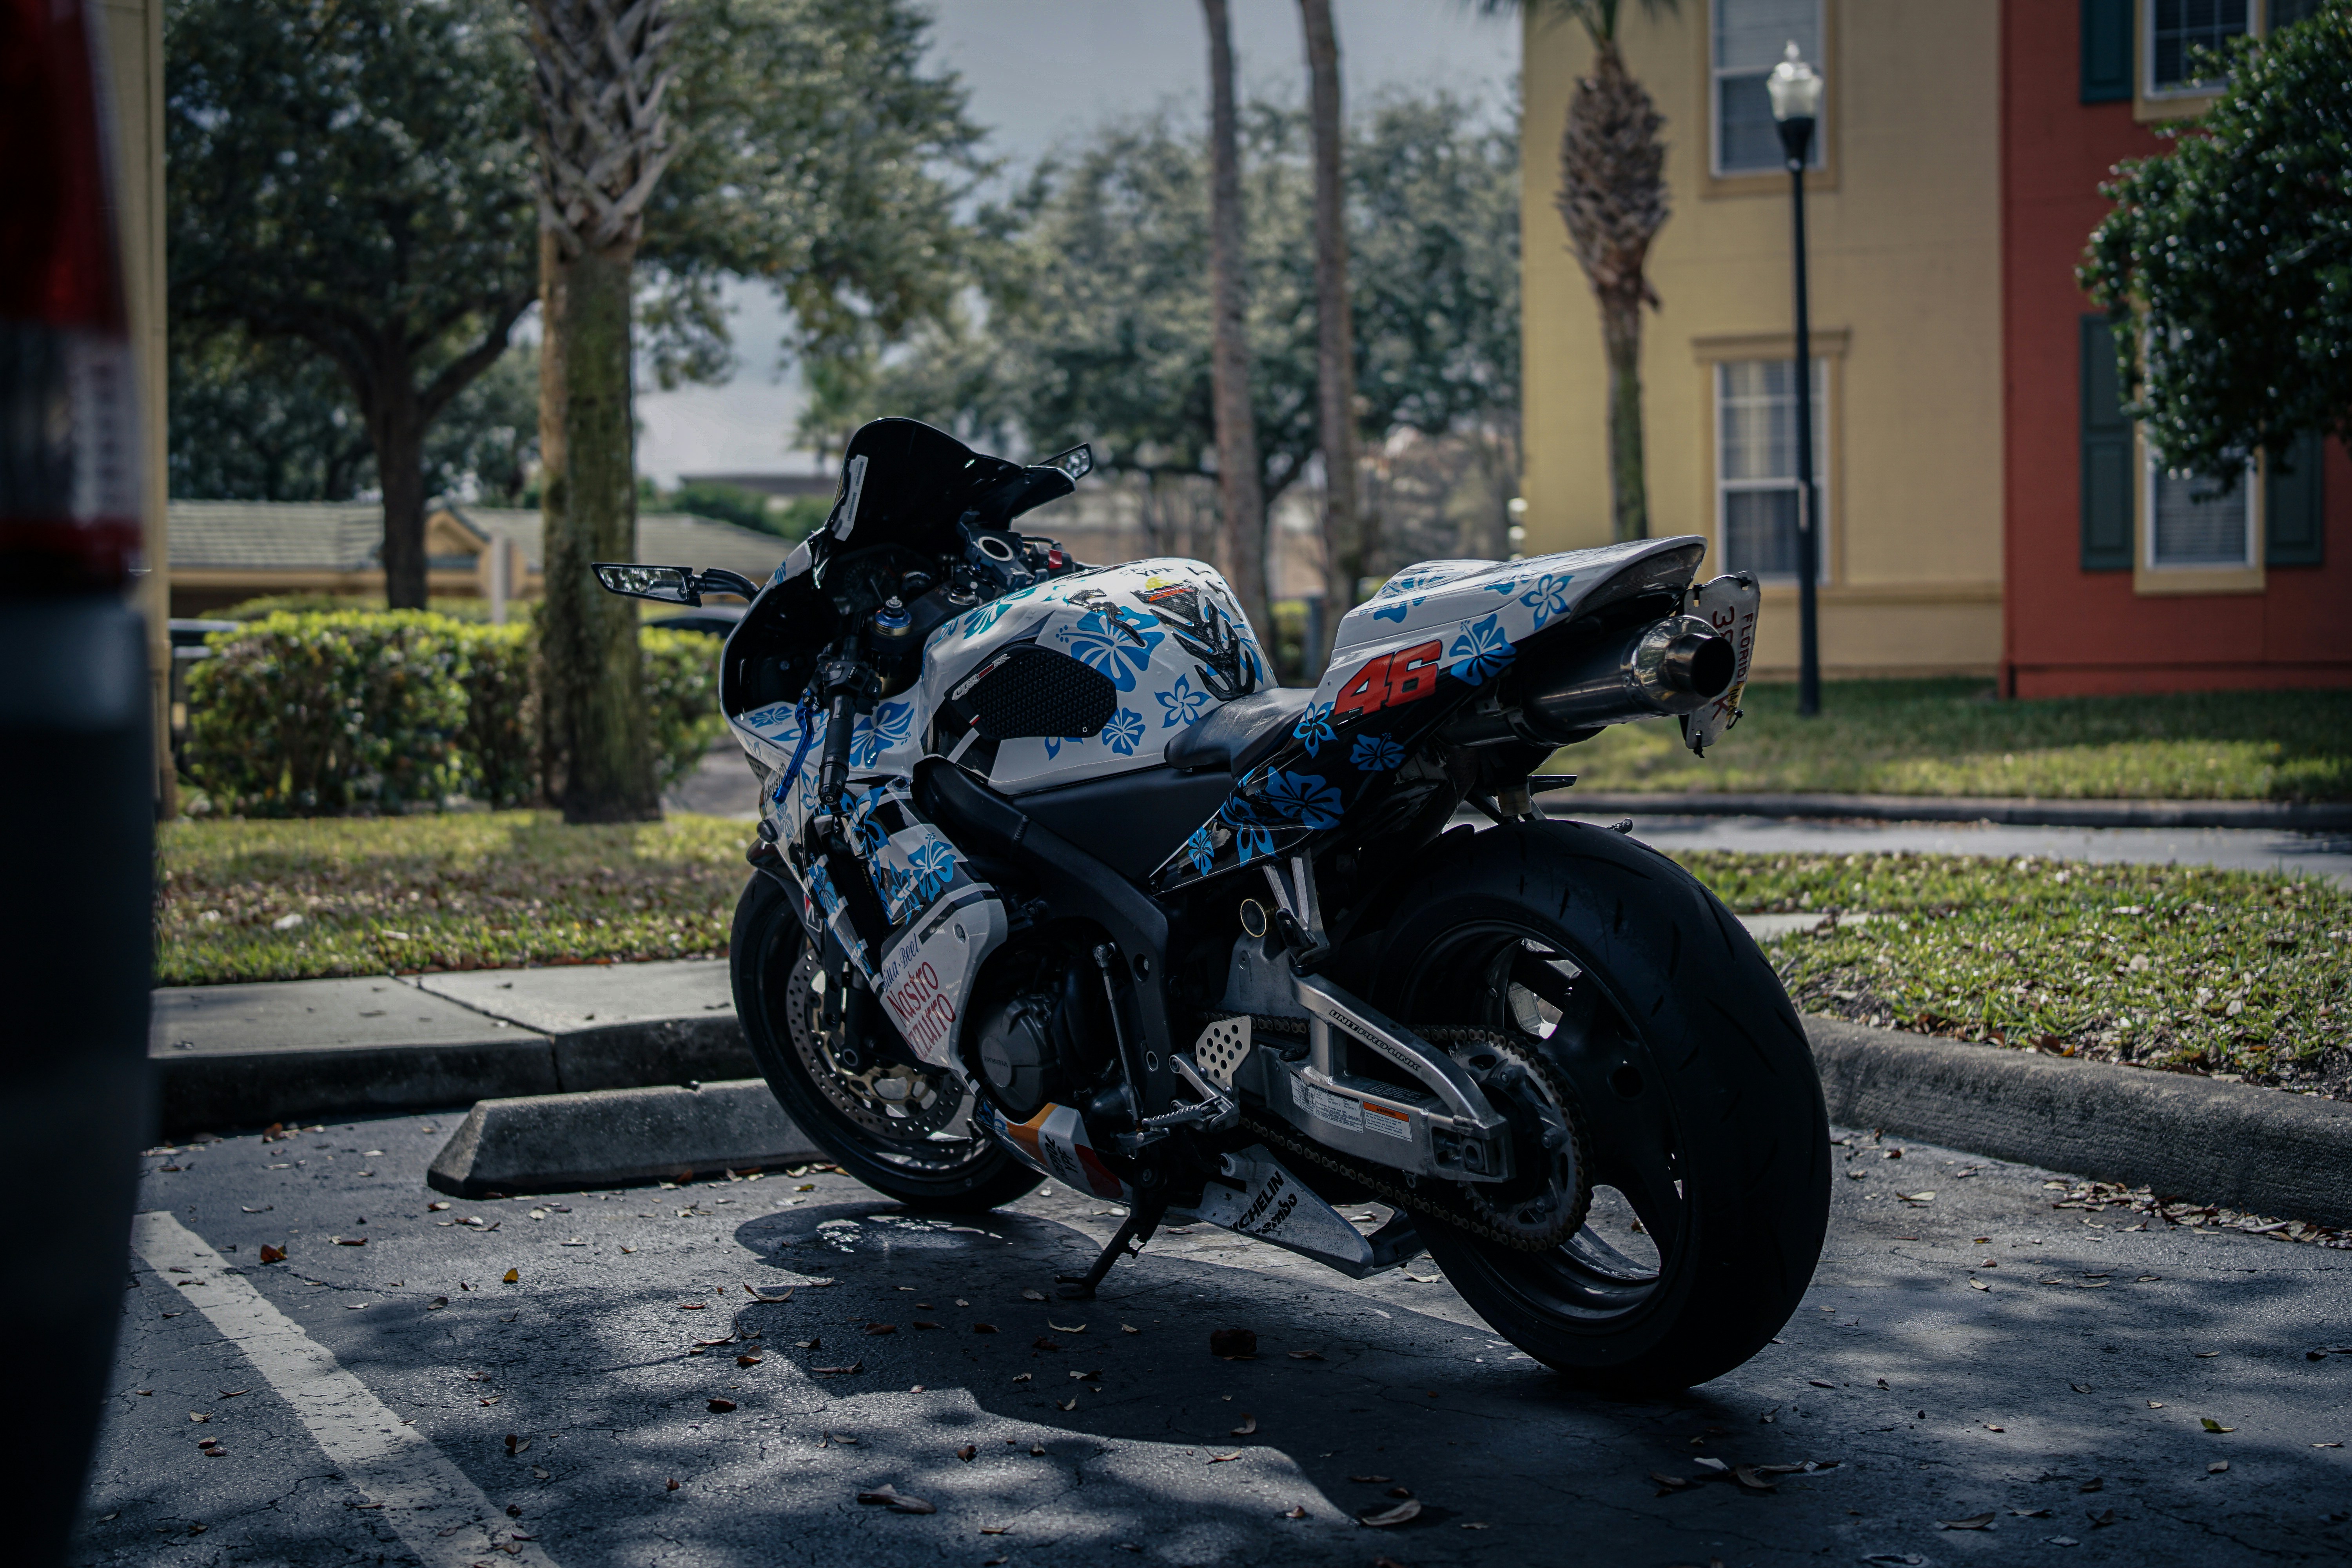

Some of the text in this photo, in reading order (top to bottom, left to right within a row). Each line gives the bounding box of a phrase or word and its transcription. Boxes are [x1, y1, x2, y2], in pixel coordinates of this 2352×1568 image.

[1334, 639, 1443, 715] 46
[1737, 612, 1753, 686] FLORID
[887, 962, 938, 1028] Nastro
[1329, 1009, 1359, 1032] UNIT
[1057, 1145, 1078, 1173] YPF
[1229, 1171, 1284, 1230] ICHELIN
